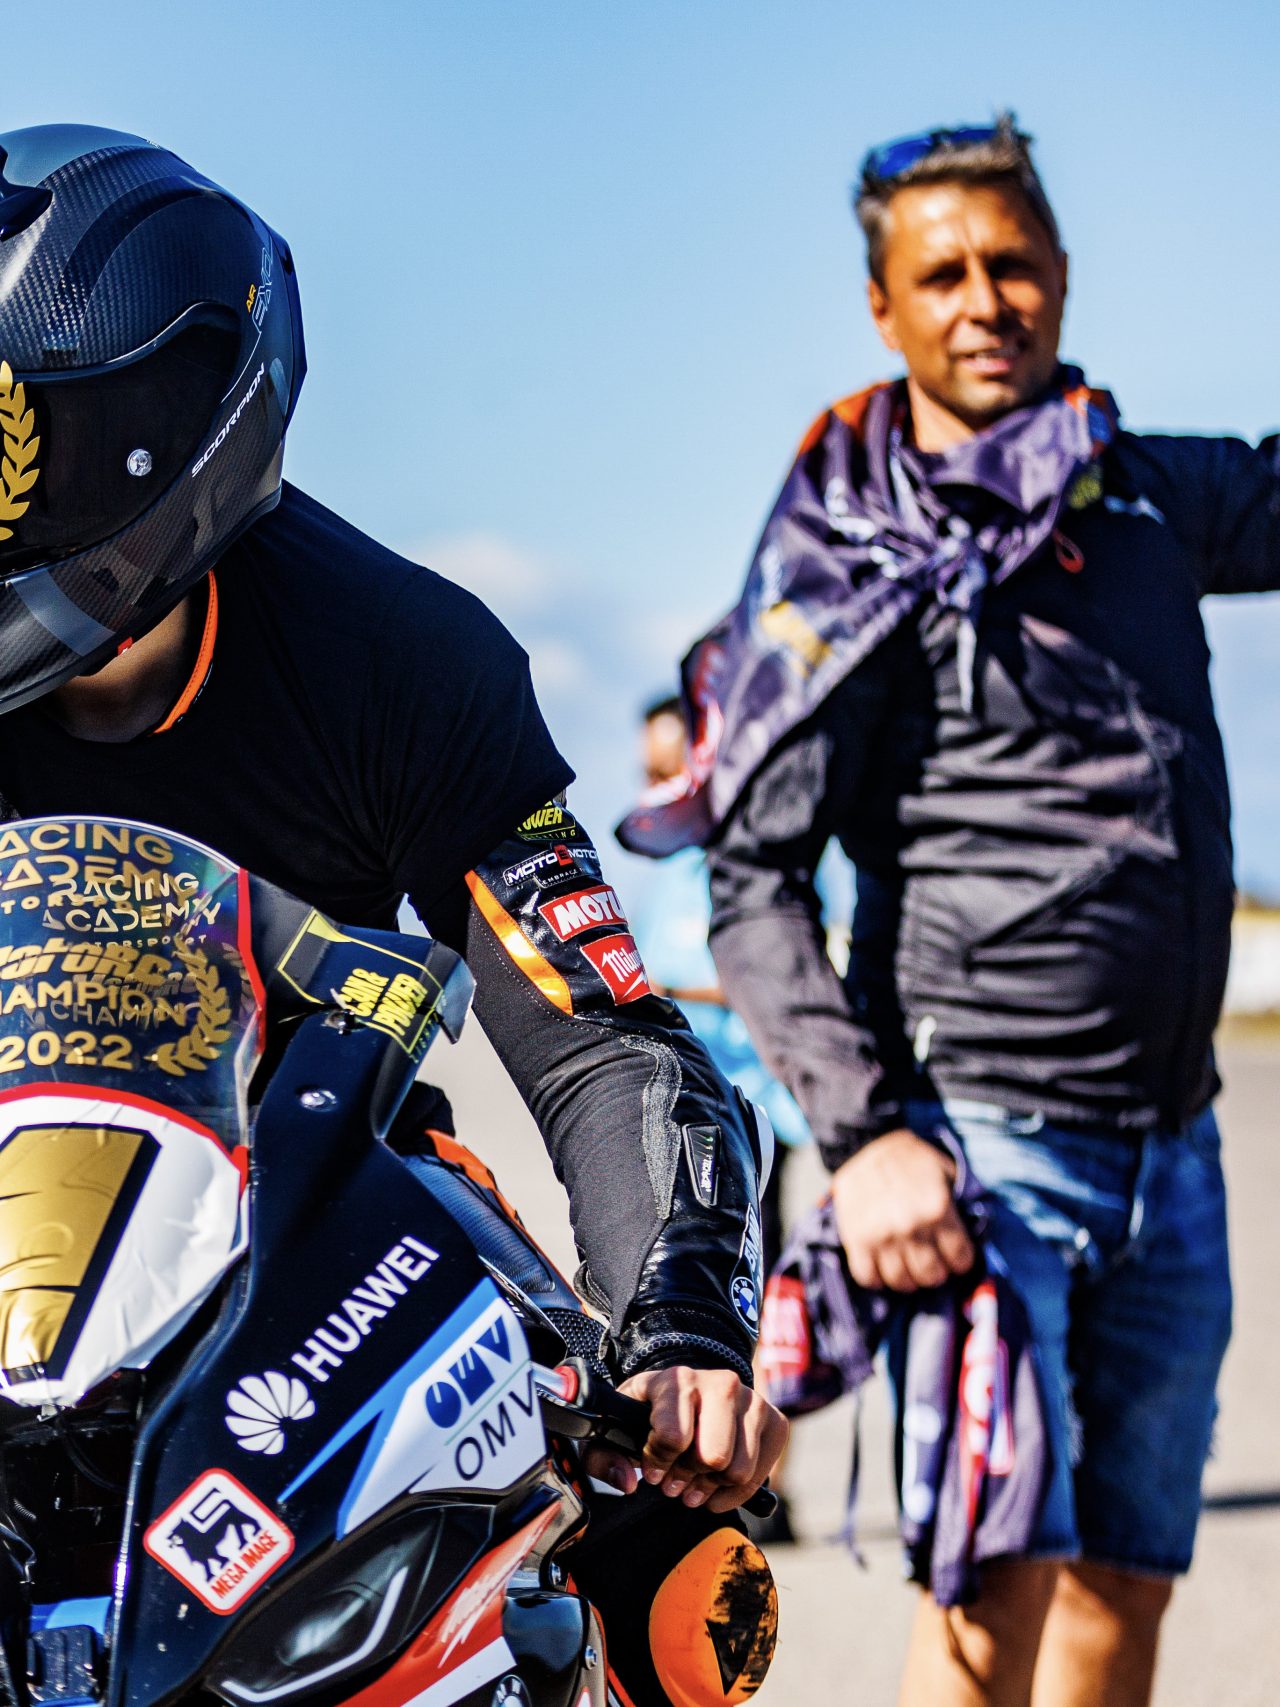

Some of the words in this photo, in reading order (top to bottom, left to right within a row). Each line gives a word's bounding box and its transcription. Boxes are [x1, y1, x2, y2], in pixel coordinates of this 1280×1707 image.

[191, 362, 265, 479] SCORPION
[517, 806, 563, 832] OWER
[51, 872, 200, 903] RACING
[553, 890, 626, 936] MOTU
[291, 1235, 441, 1383] HUAWEI
[454, 1369, 539, 1482] OMV
[210, 1562, 248, 1599] MEGA
[240, 1529, 280, 1569] IMAGE
